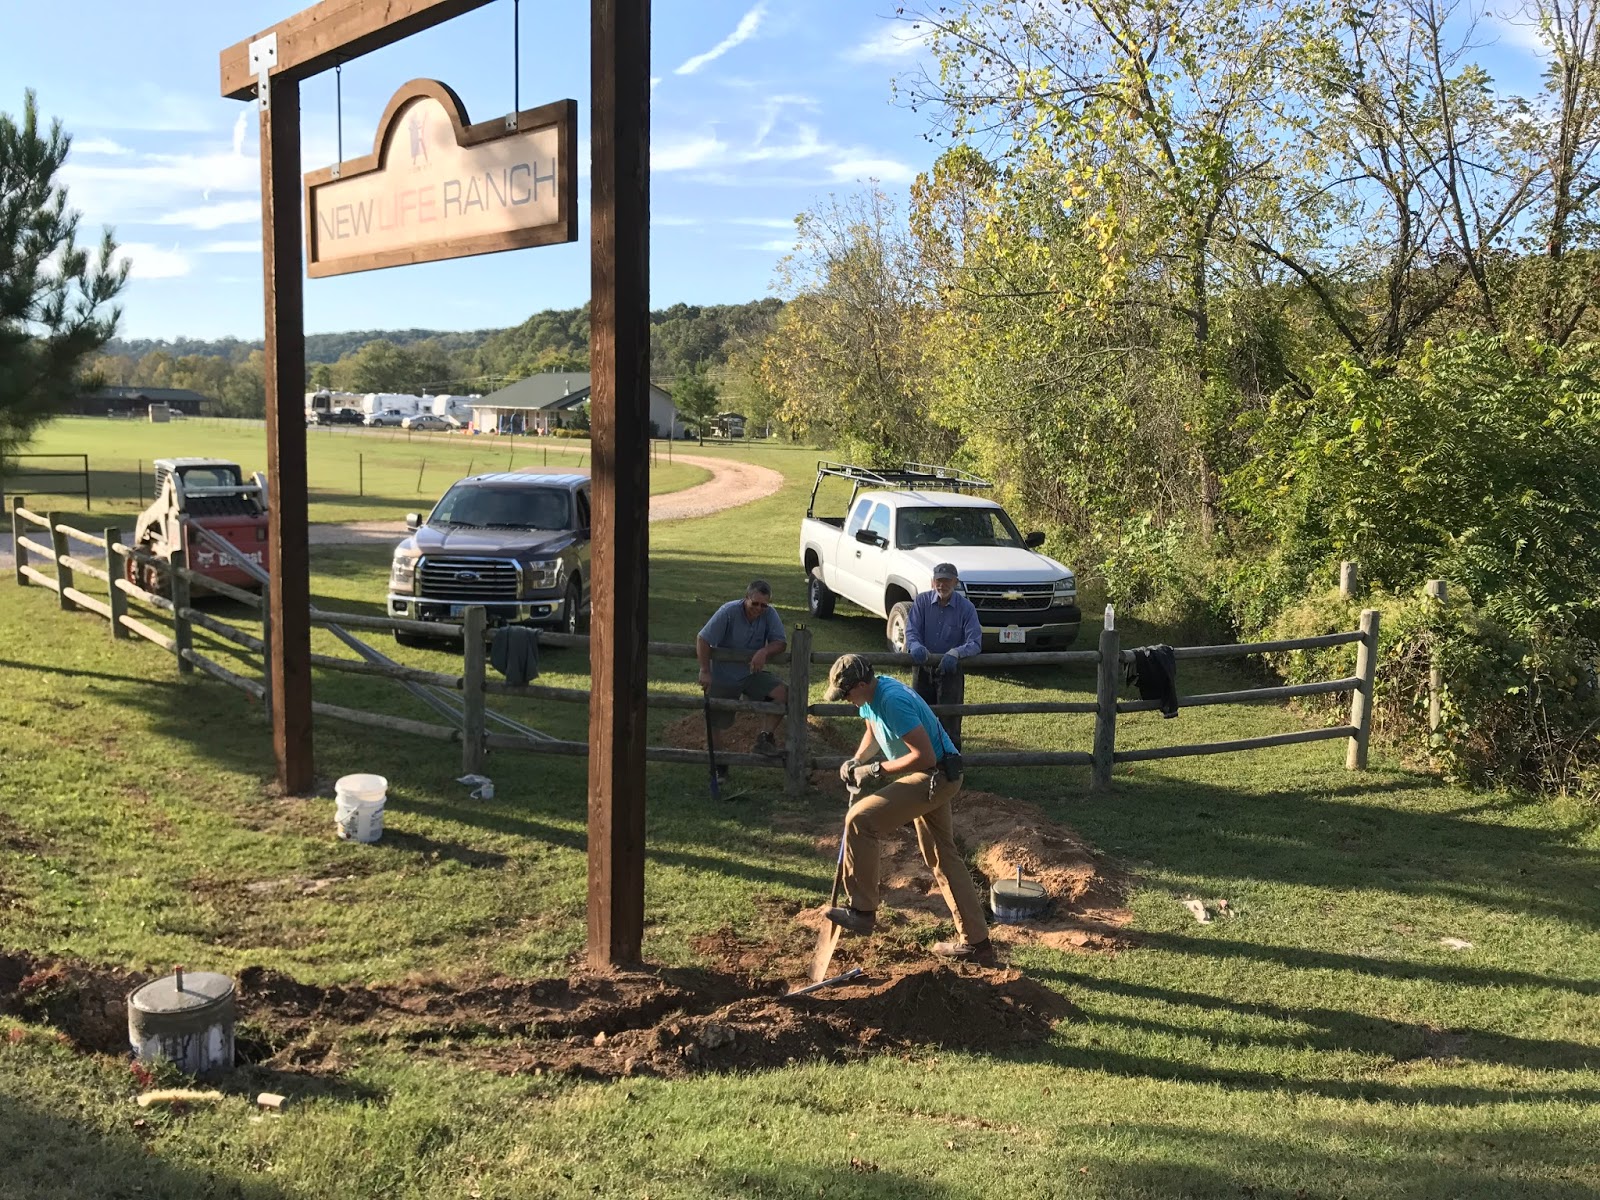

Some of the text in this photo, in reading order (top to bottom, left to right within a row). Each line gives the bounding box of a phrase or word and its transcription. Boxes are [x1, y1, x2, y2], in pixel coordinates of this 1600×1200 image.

[317, 157, 556, 241] NEW LIFE RANCH
[219, 551, 262, 566] Bcat
